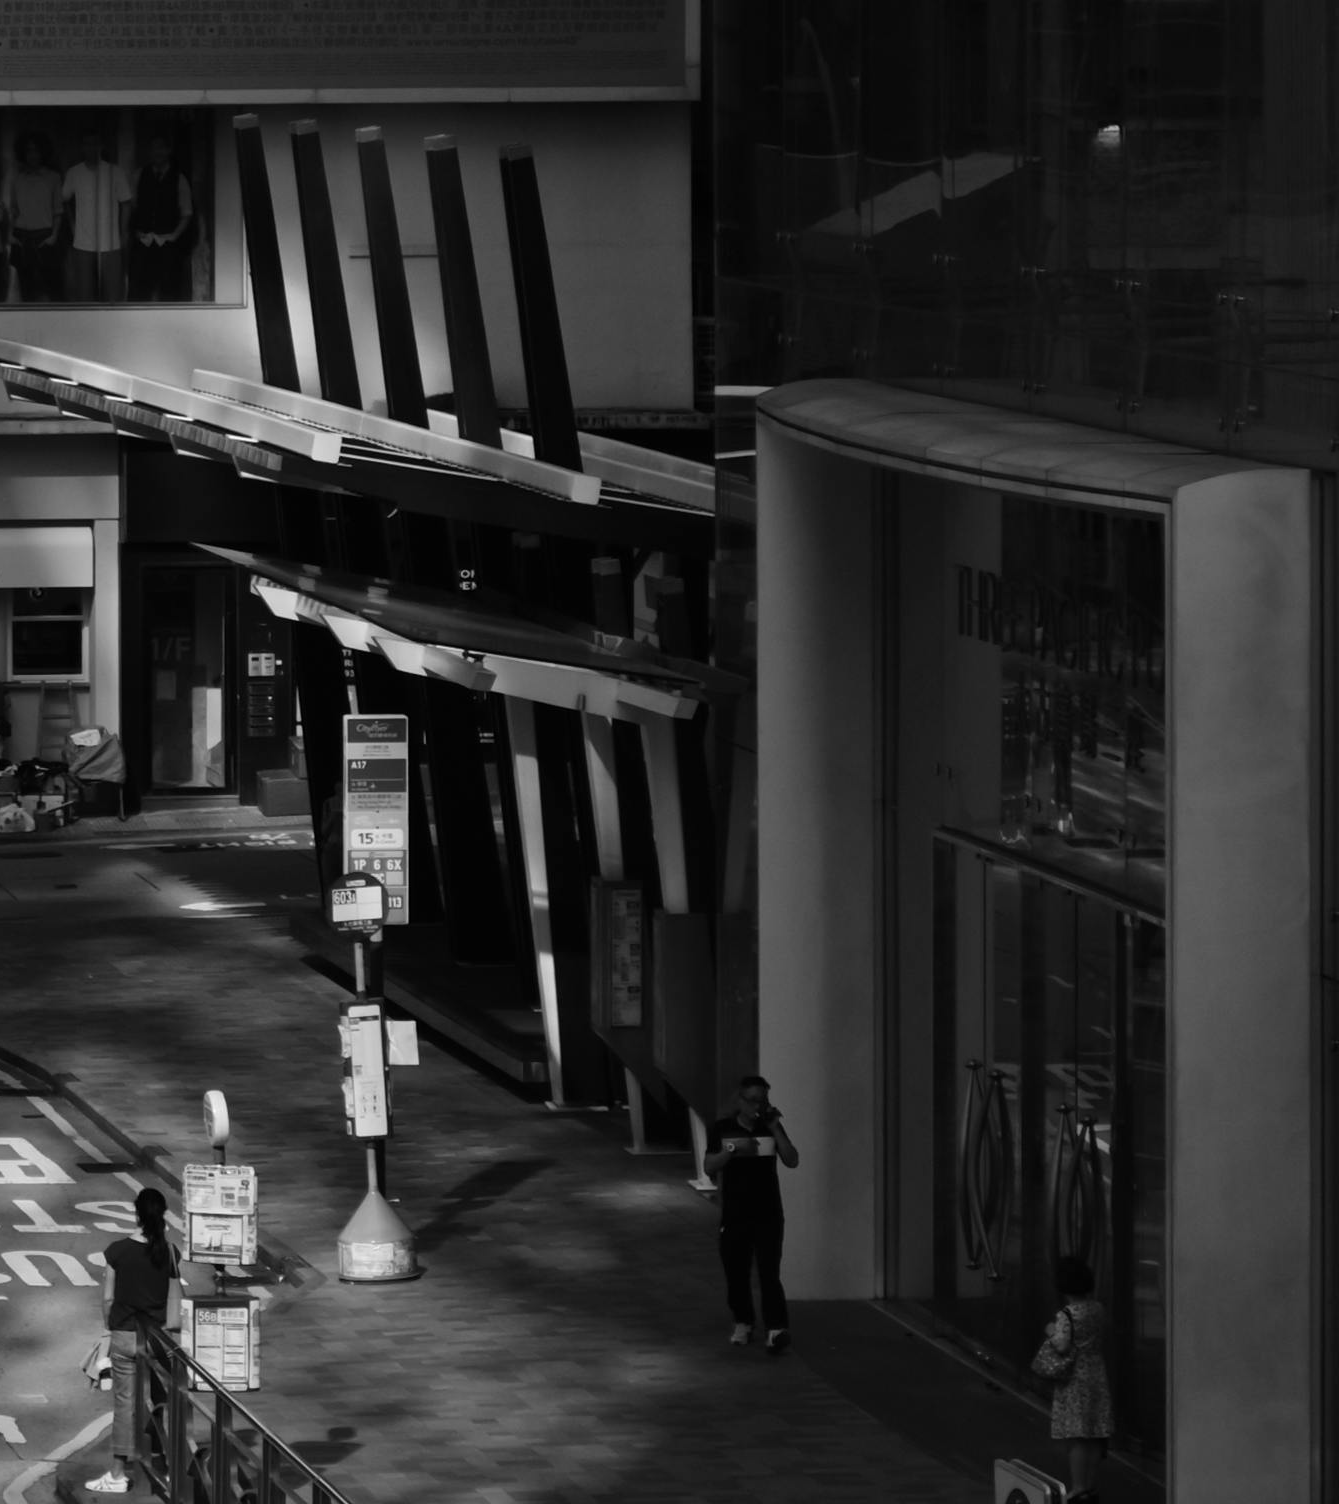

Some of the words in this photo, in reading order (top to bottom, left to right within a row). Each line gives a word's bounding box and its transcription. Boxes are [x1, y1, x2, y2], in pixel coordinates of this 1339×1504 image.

[358, 832, 374, 845] 15
[353, 859, 367, 871] 1P
[373, 859, 381, 871] 6
[386, 859, 403, 871] 6X
